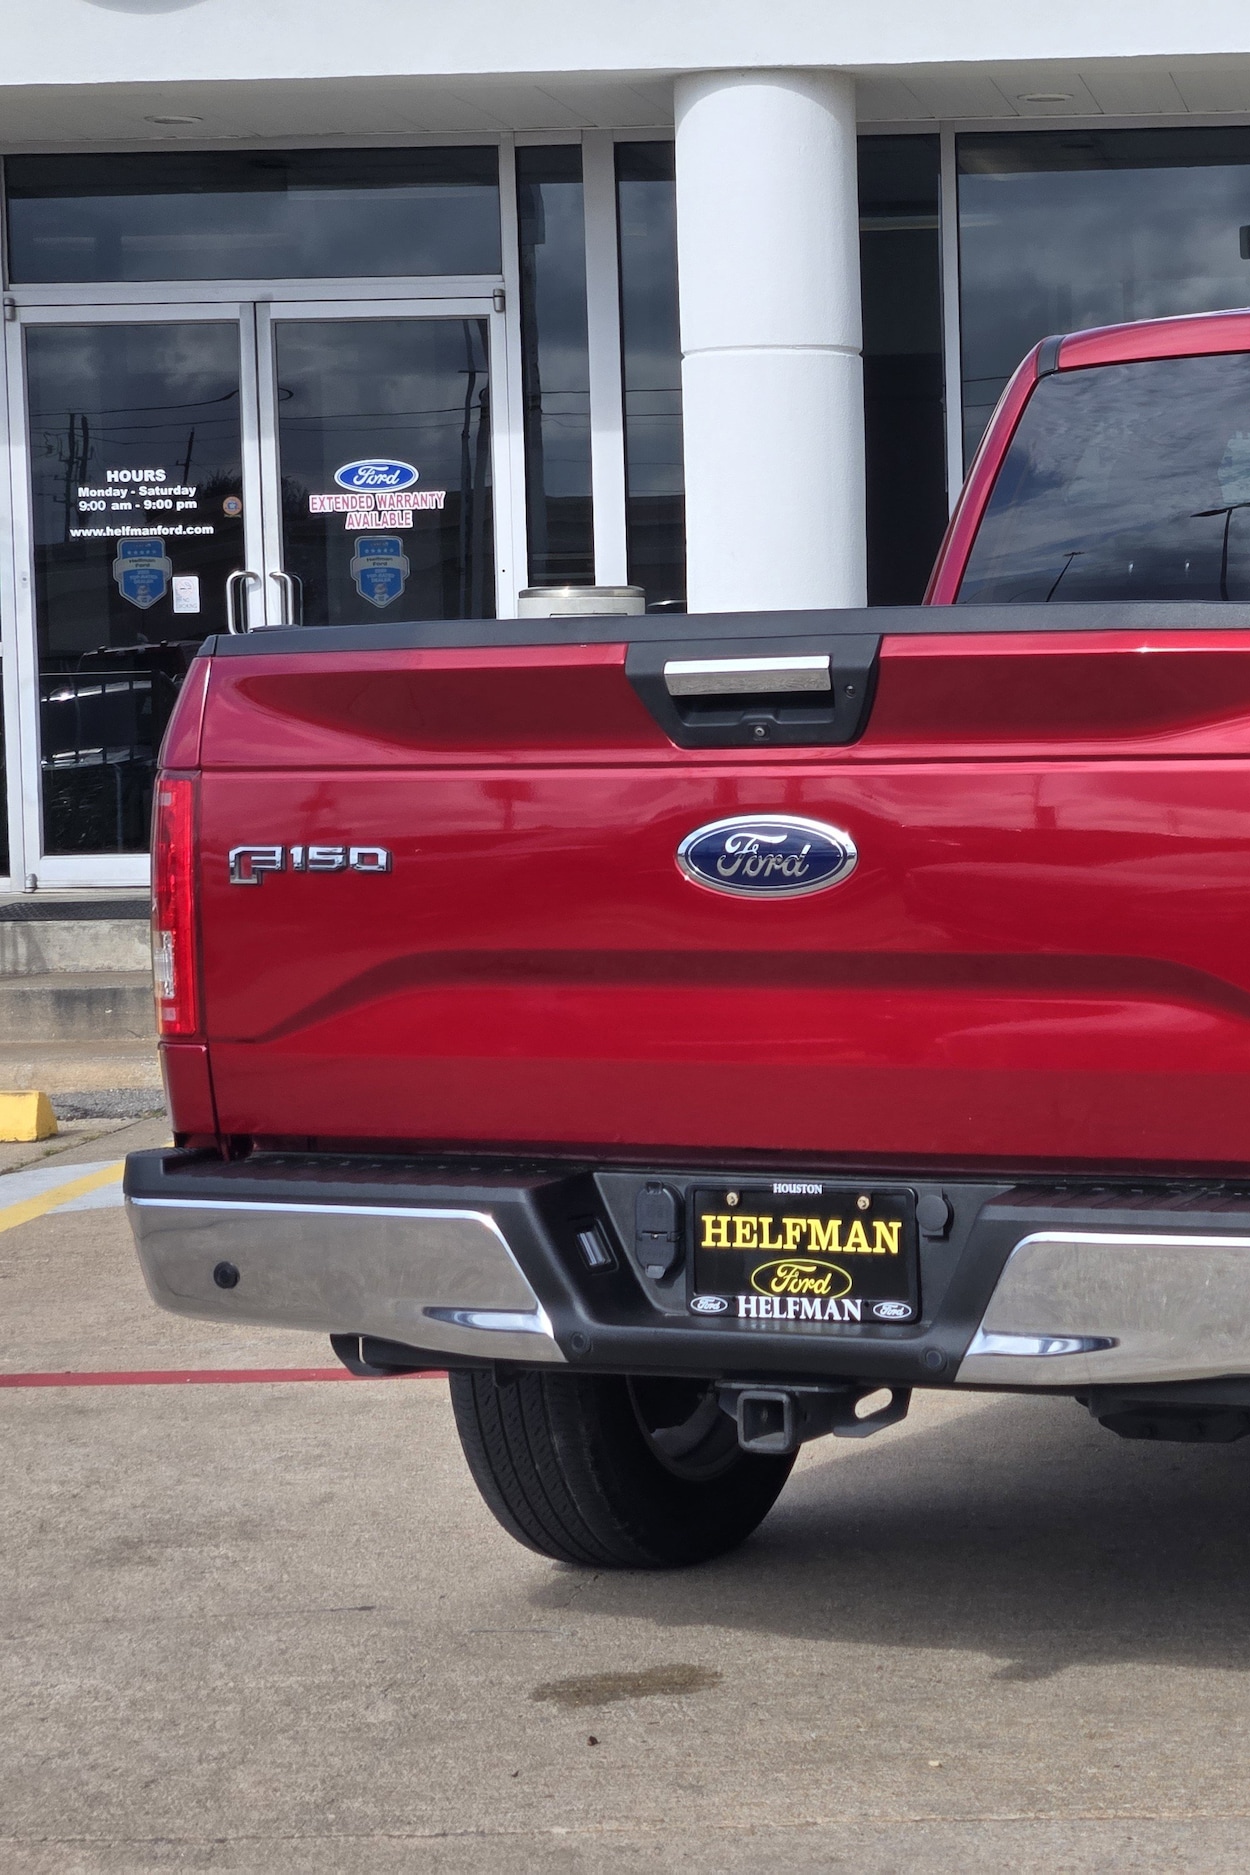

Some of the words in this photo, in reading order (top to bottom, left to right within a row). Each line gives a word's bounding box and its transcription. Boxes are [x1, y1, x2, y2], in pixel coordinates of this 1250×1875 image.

[106, 469, 167, 483] HOURS
[353, 465, 401, 486] Ford
[77, 487, 128, 499] Monday
[138, 485, 197, 498] Saturday
[79, 500, 106, 511] 9:00
[111, 502, 133, 510] am
[143, 499, 173, 510] 9:00
[176, 500, 198, 511] pm
[310, 495, 373, 512] EXTENDED
[376, 492, 445, 510] WARRANTY
[346, 511, 412, 528] AVAILABLE
[69, 525, 214, 537] www.helfmanford.com
[716, 832, 811, 879] Ford
[773, 1183, 823, 1194] HOUSTON
[701, 1214, 902, 1254] HELFMAN
[771, 1263, 832, 1295] Ford
[696, 1298, 721, 1312] Ford
[737, 1295, 863, 1322] HELFMAN
[879, 1303, 905, 1317] Ford
